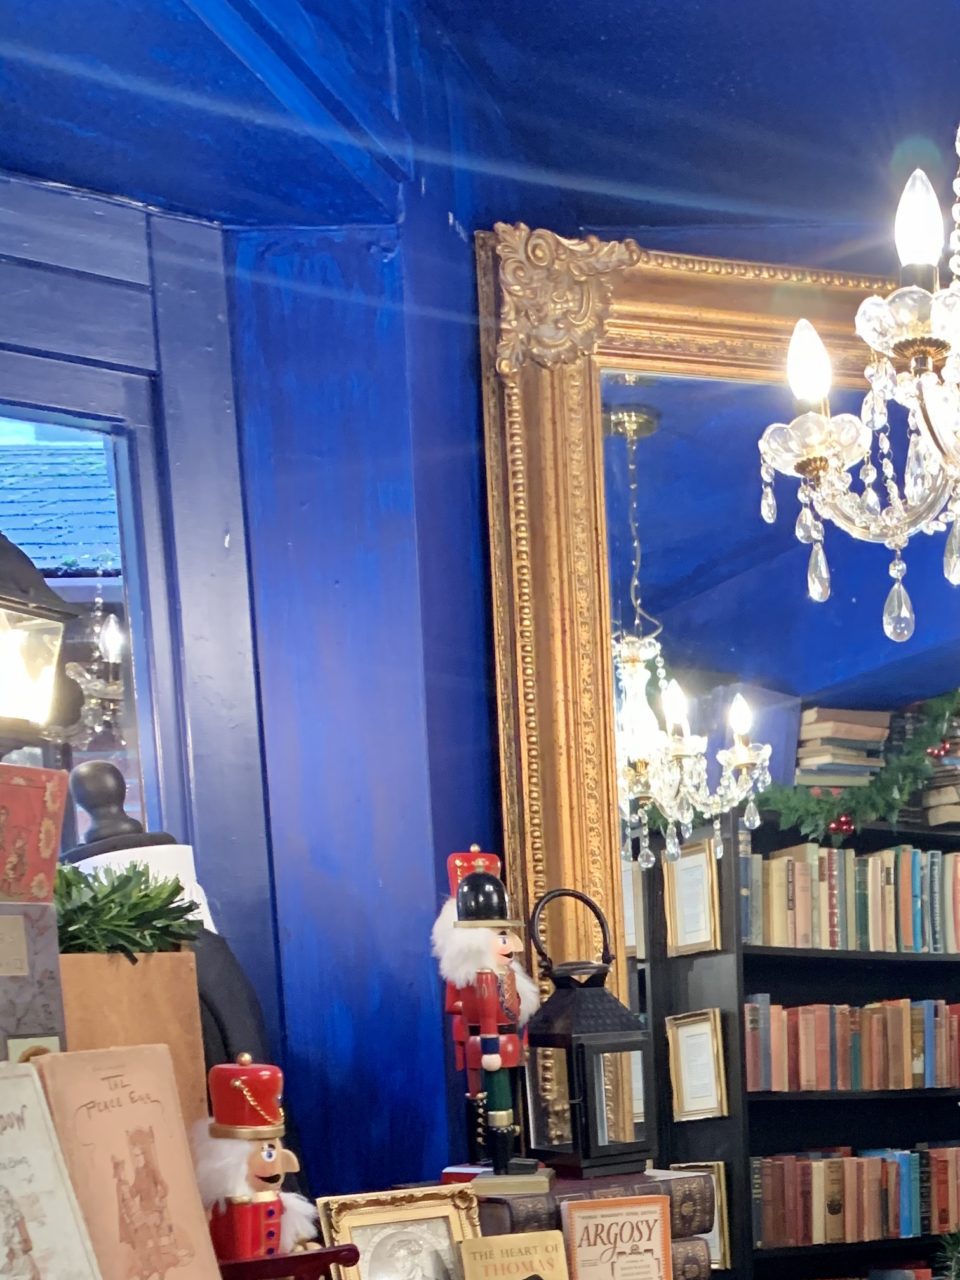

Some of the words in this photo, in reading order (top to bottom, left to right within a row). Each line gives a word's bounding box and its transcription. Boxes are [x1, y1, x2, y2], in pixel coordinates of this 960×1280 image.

[471, 1249, 495, 1260] THE
[500, 1245, 538, 1258] HEART
[544, 1243, 559, 1253] OF
[577, 1219, 659, 1264] ARGOSY
[483, 1257, 554, 1277] THOMAS
